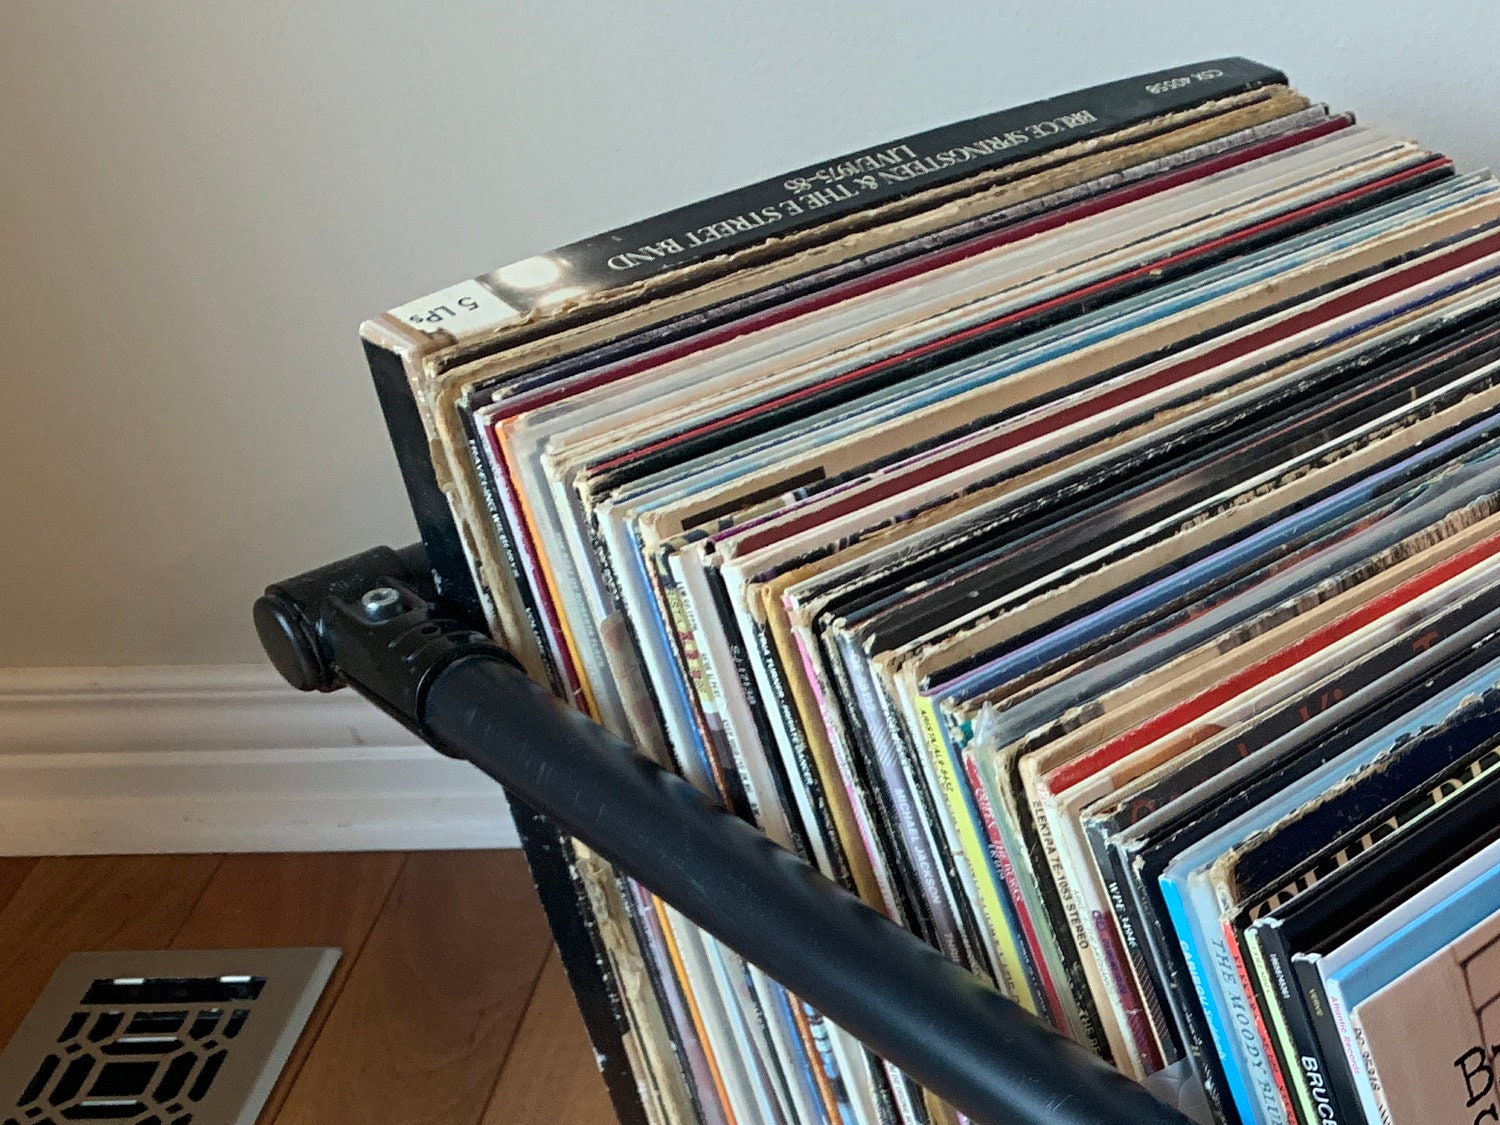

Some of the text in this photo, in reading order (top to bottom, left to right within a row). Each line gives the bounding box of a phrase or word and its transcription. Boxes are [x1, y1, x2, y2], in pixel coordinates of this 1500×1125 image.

[607, 109, 1098, 271] BRUCE SPRINGSTEEN & THE E STREET BAND
[408, 296, 478, 326] 5 LPs
[764, 656, 785, 699] TURNER
[893, 786, 942, 905] MICHAEL JACKSON
[1031, 798, 1089, 951] ELEKTRA 7E-1053 STEREO
[1211, 939, 1235, 983] THE
[1227, 991, 1268, 1077] MOODY
[1330, 995, 1361, 1076] Atlantic Records
